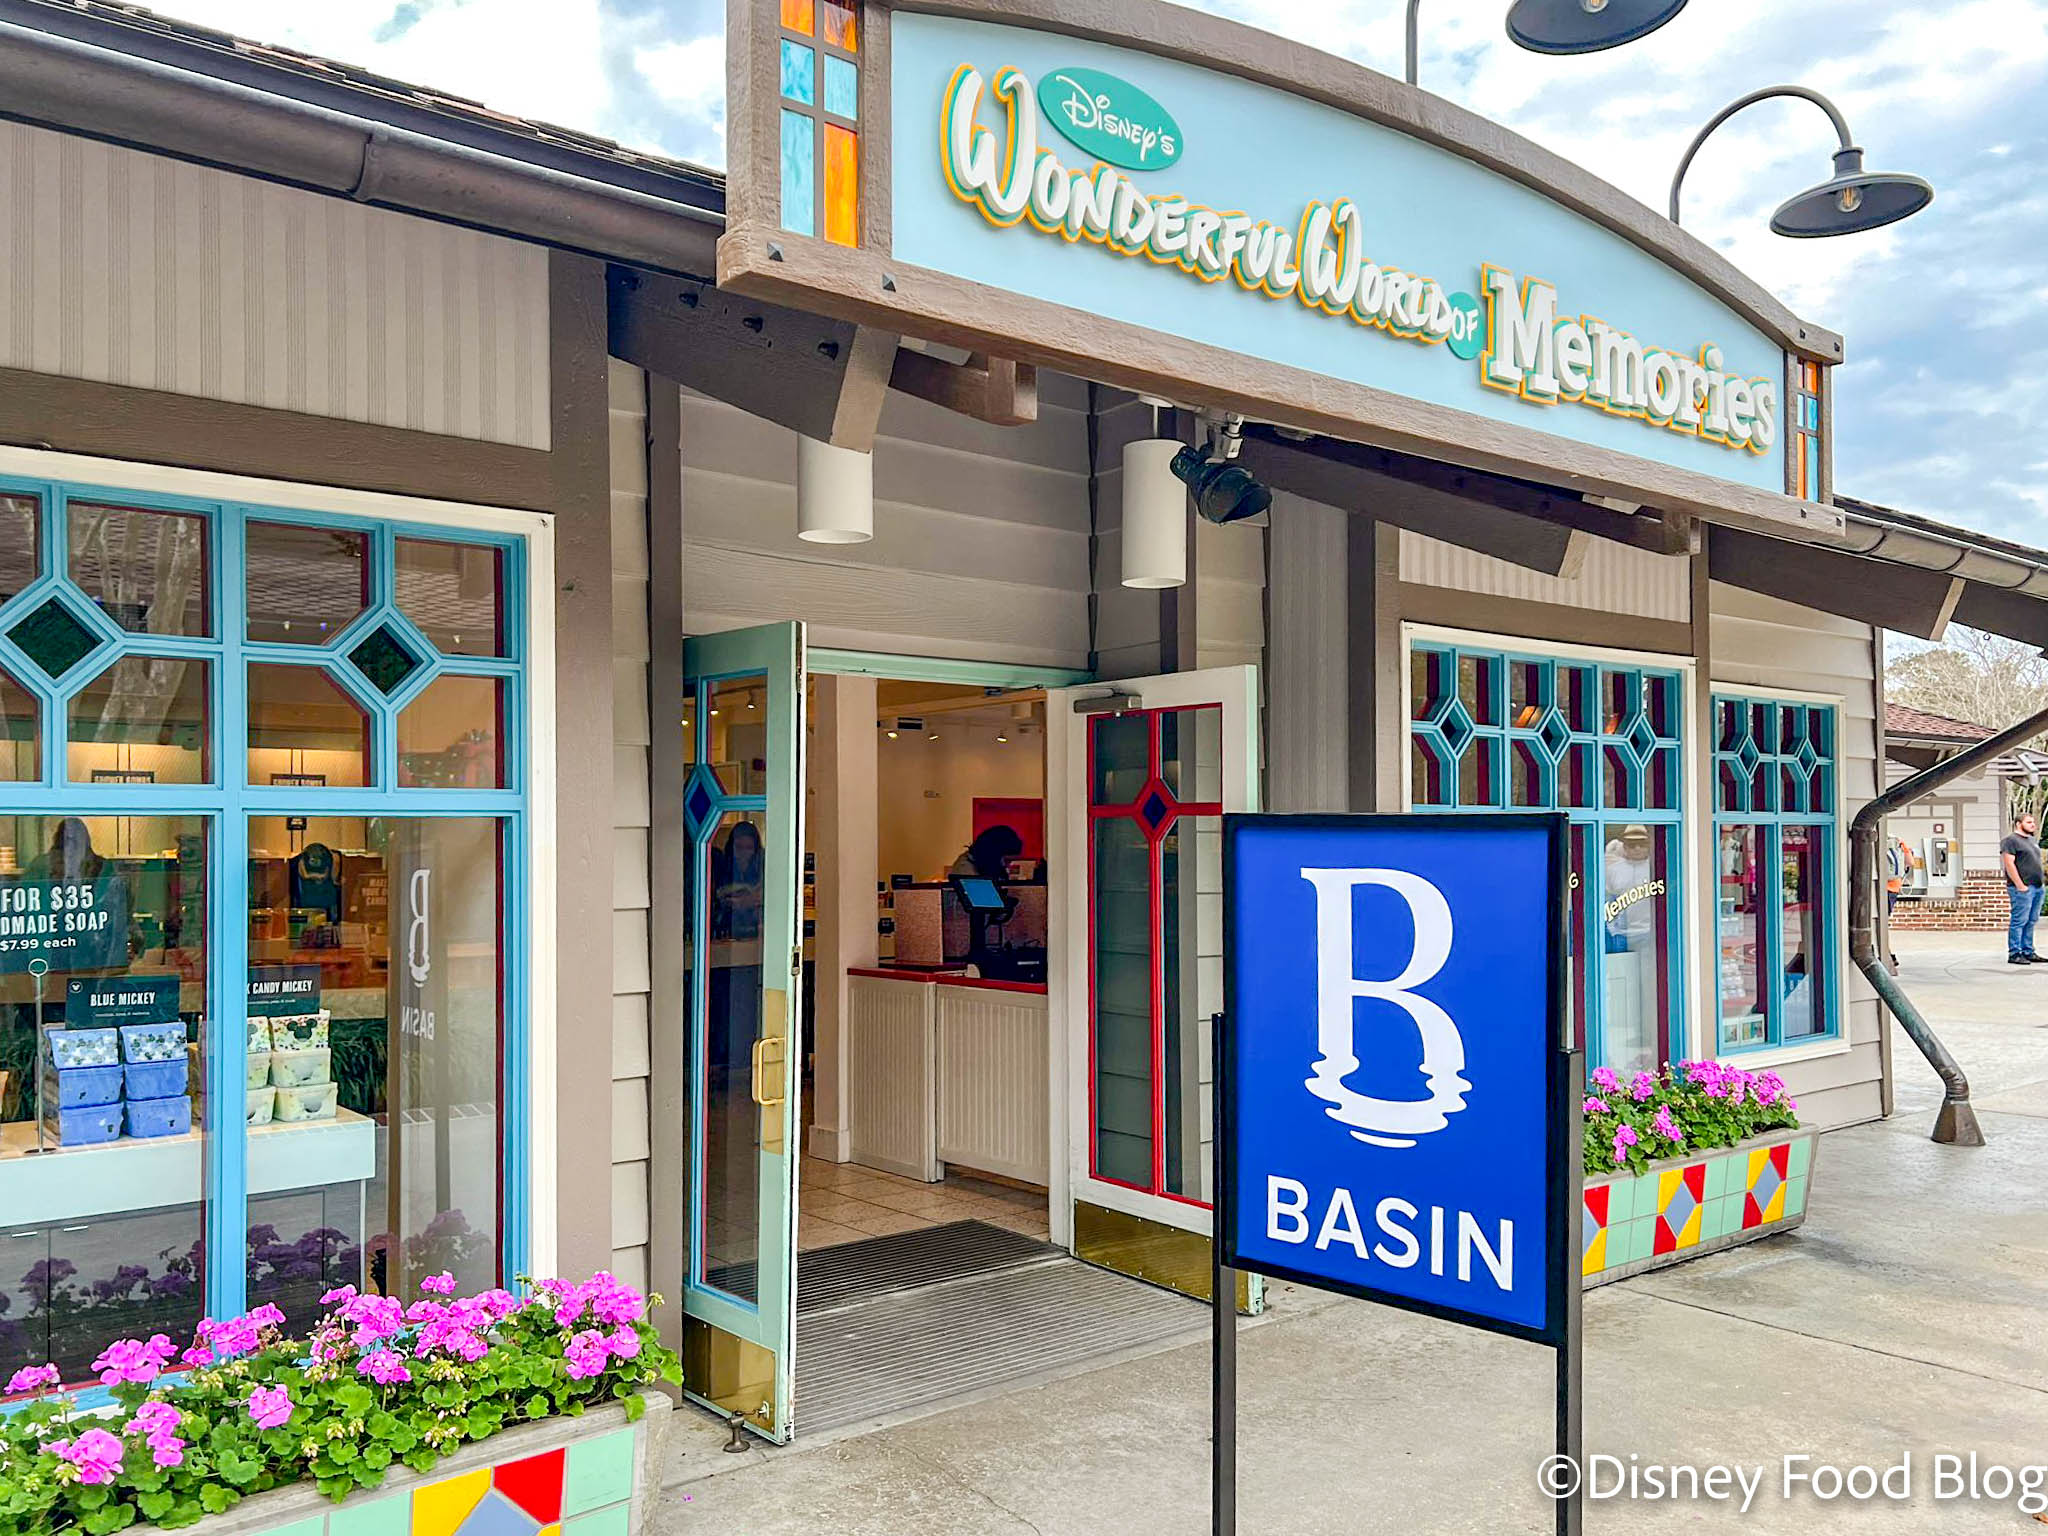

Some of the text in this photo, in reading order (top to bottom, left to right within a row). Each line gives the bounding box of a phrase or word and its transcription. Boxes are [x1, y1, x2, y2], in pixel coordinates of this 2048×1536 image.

[1482, 264, 1778, 456] Memories
[0, 884, 94, 913] FOR $35
[0, 911, 108, 936] DMADE SOAP
[0, 936, 76, 952] $7.99 each
[90, 991, 156, 1007] BLUE MICKEY
[252, 981, 280, 995] CANDY
[282, 979, 312, 993] MICKEY
[1300, 866, 1472, 1148] B
[1266, 1174, 1514, 1293] BASIN
